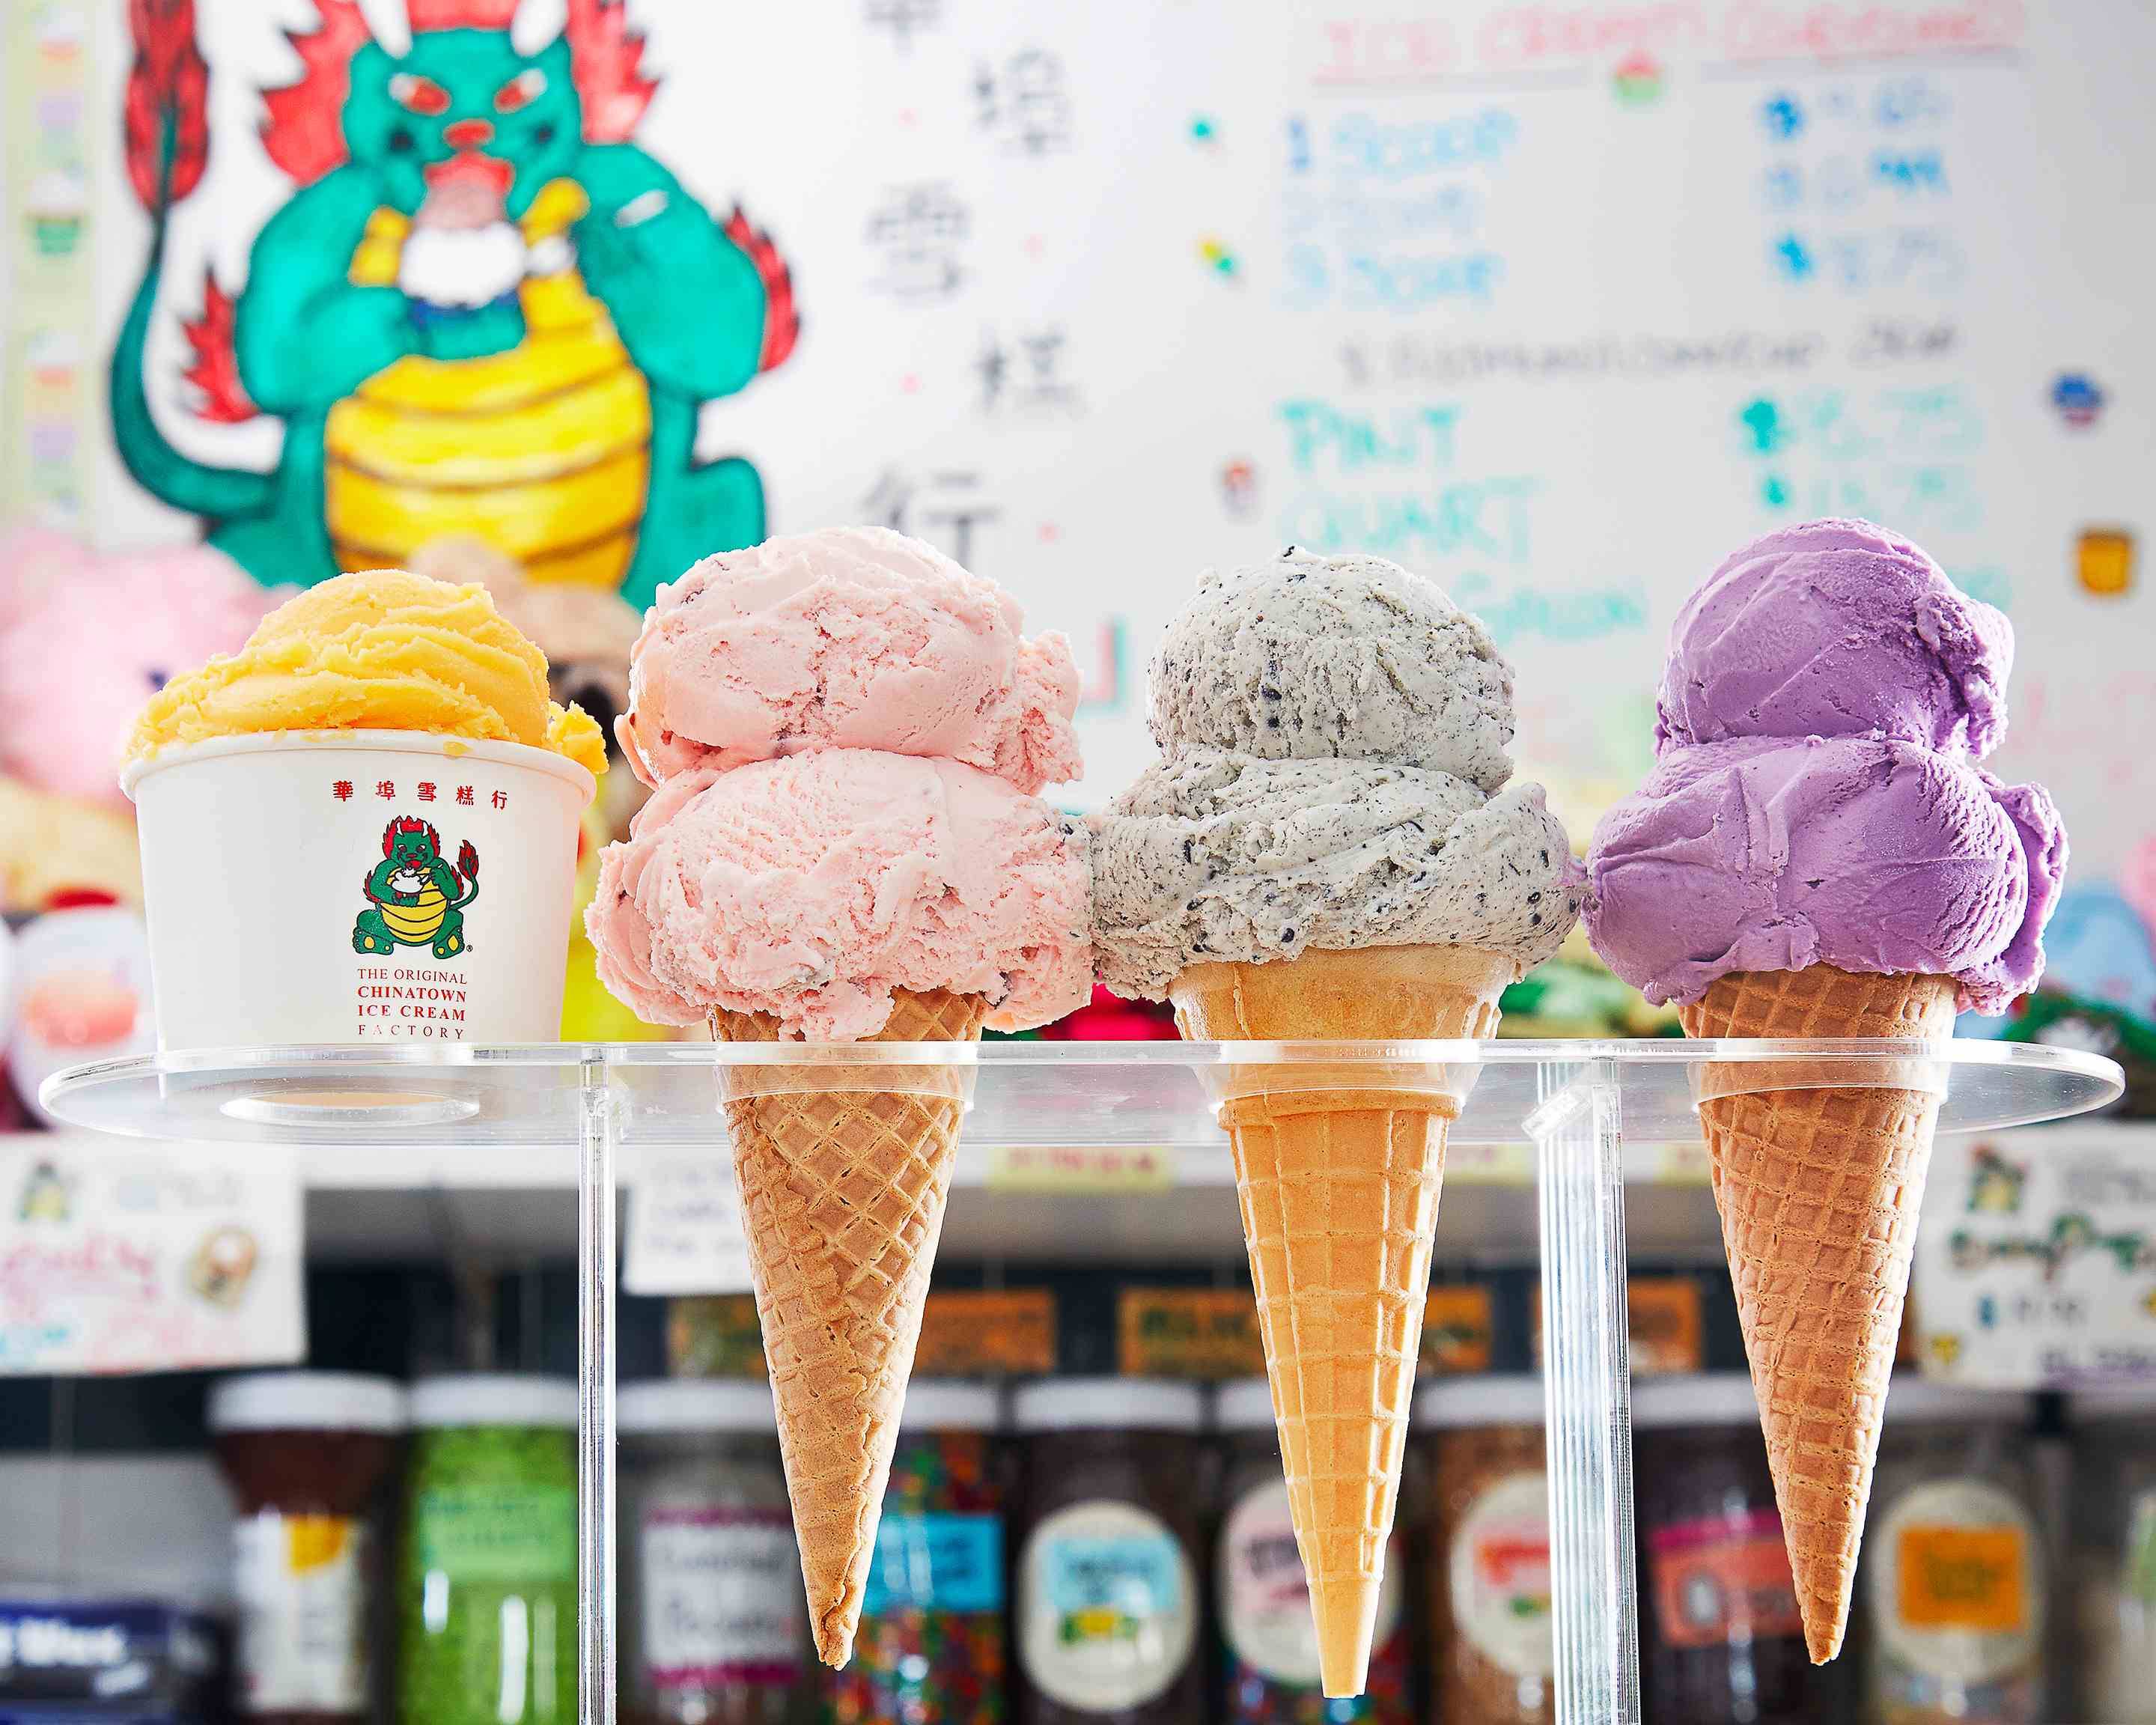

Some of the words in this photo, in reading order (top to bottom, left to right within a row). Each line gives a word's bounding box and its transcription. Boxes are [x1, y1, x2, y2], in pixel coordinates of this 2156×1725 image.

[332, 779, 508, 810] 華埠雪糕行
[357, 969, 388, 979] THE
[394, 969, 468, 985] ORIGINAL
[357, 986, 466, 1003] CHINATOWN
[358, 1005, 391, 1017] ICE
[401, 1005, 465, 1021] CREAM
[358, 1024, 464, 1040] FACTORY
